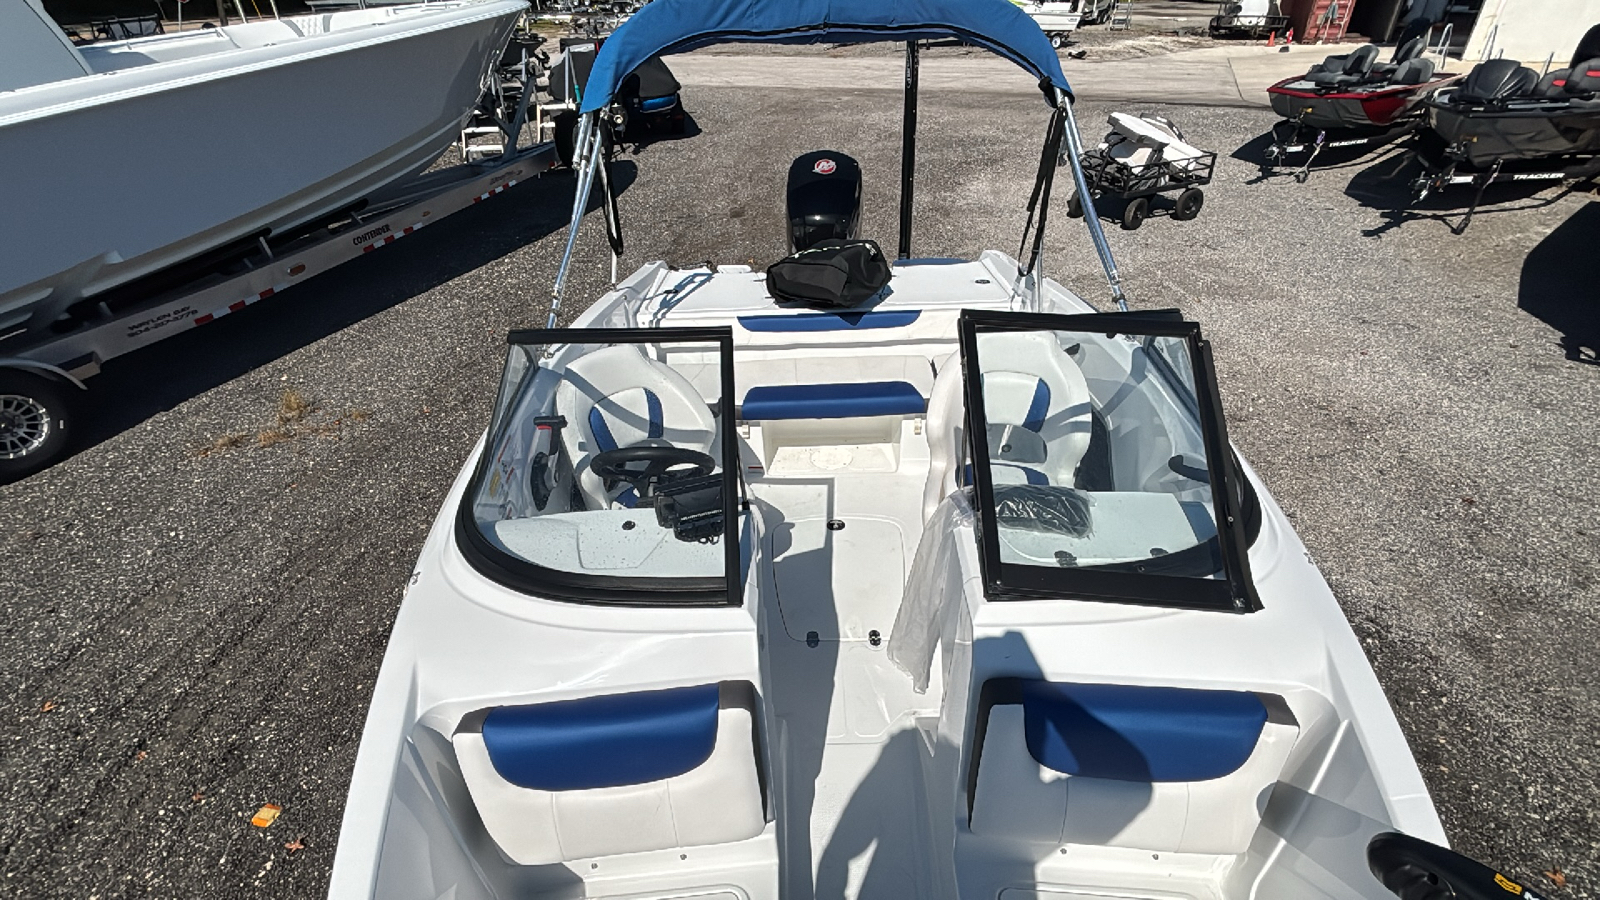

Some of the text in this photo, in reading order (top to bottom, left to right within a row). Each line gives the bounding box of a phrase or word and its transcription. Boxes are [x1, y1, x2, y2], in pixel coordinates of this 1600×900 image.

[1328, 138, 1369, 147] TRACKER
[1512, 172, 1565, 181] TRACKER
[352, 224, 391, 246] CONTENDER
